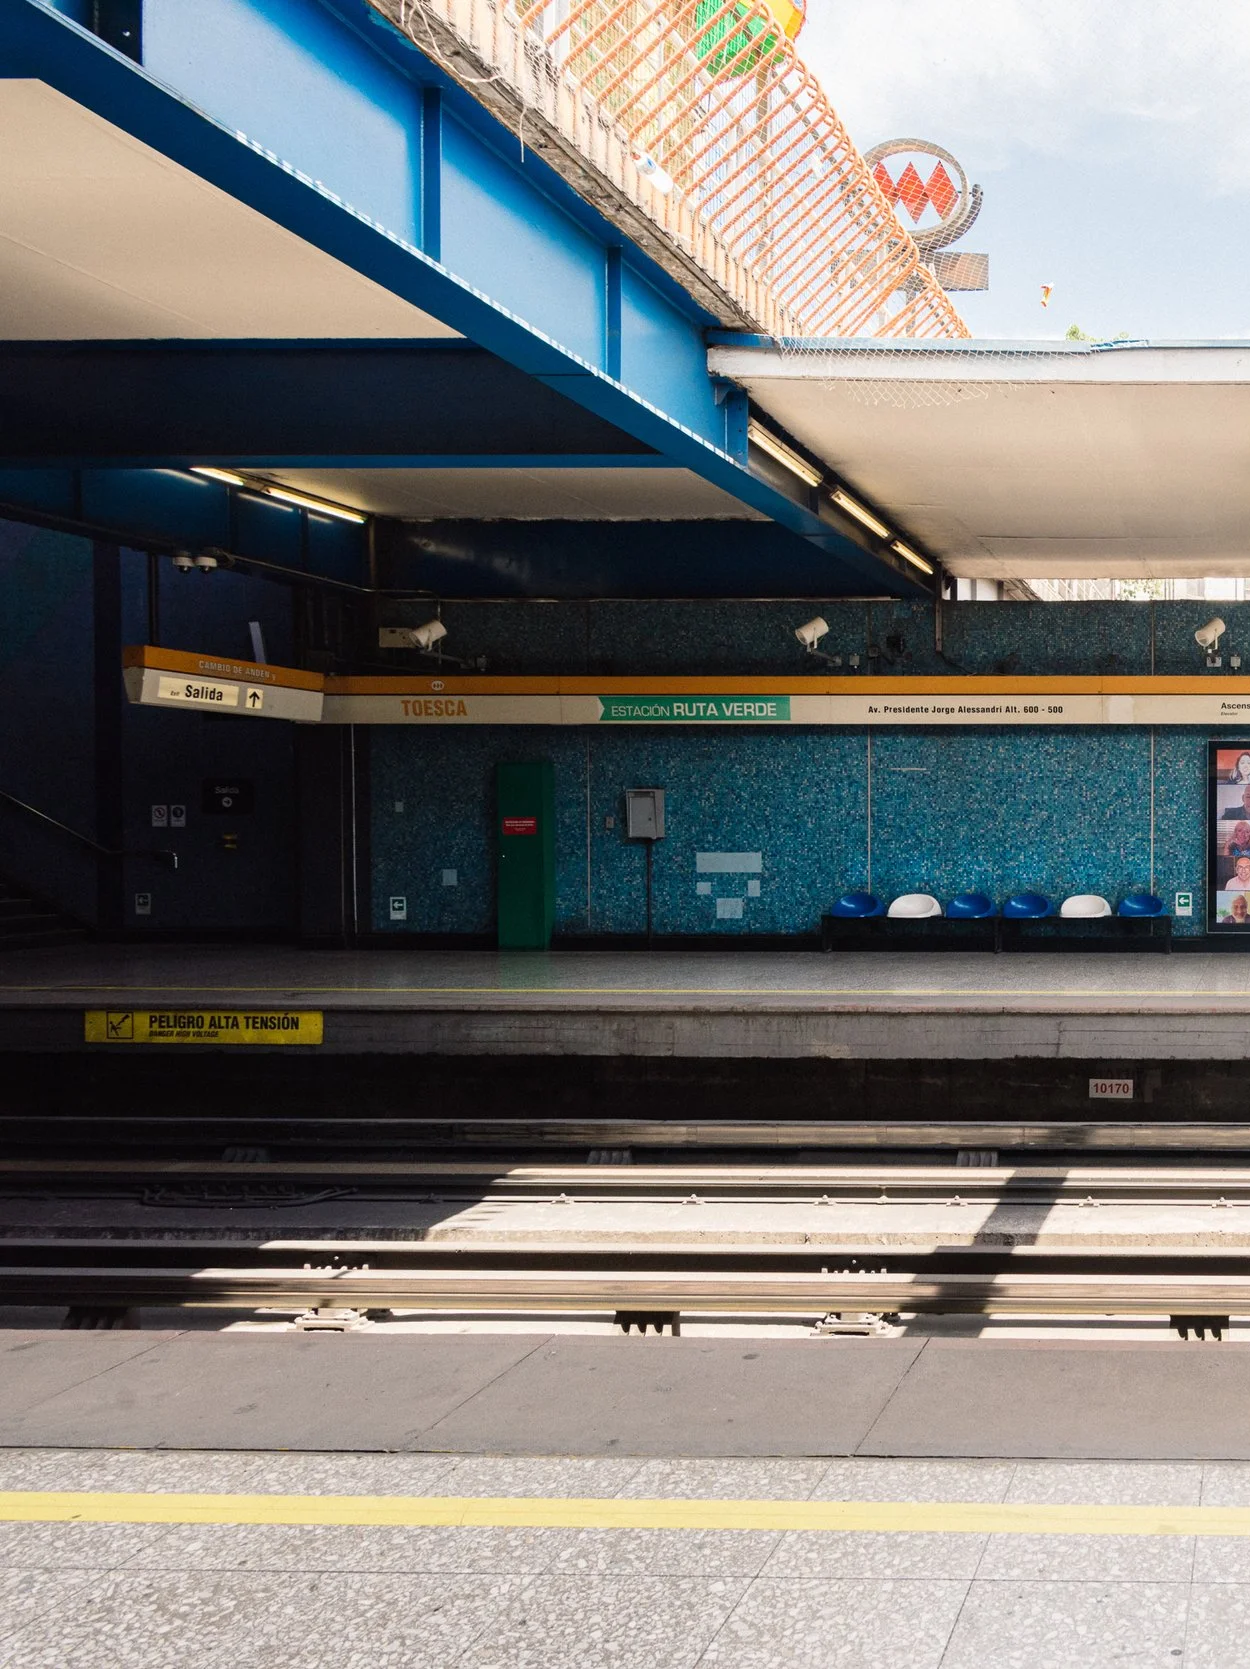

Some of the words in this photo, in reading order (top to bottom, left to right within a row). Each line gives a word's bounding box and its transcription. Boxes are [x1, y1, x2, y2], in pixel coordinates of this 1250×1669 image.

[198, 660, 231, 673] CAMBIO
[232, 665, 243, 674] DE
[245, 667, 270, 679] ANDEN
[185, 684, 223, 701] Salida
[401, 699, 467, 717] TOESCA
[611, 701, 670, 717] ESTACIÓN
[673, 702, 718, 717] RUTA
[721, 702, 777, 717] VERDE
[868, 705, 881, 714] Av.
[883, 705, 929, 714] Presidente
[931, 705, 955, 715] Jorge
[957, 705, 1003, 714] Alessandri
[1005, 705, 1021, 714] Alt.
[1023, 705, 1039, 714] 600
[1047, 705, 1064, 714] 500
[214, 786, 240, 795] Salida
[149, 1014, 205, 1029] PELIGRO
[208, 1015, 240, 1030] ALTA
[244, 1013, 299, 1030] TENSIÓN
[192, 1030, 219, 1038] VOLTAGE
[1093, 1082, 1130, 1094] 10170
